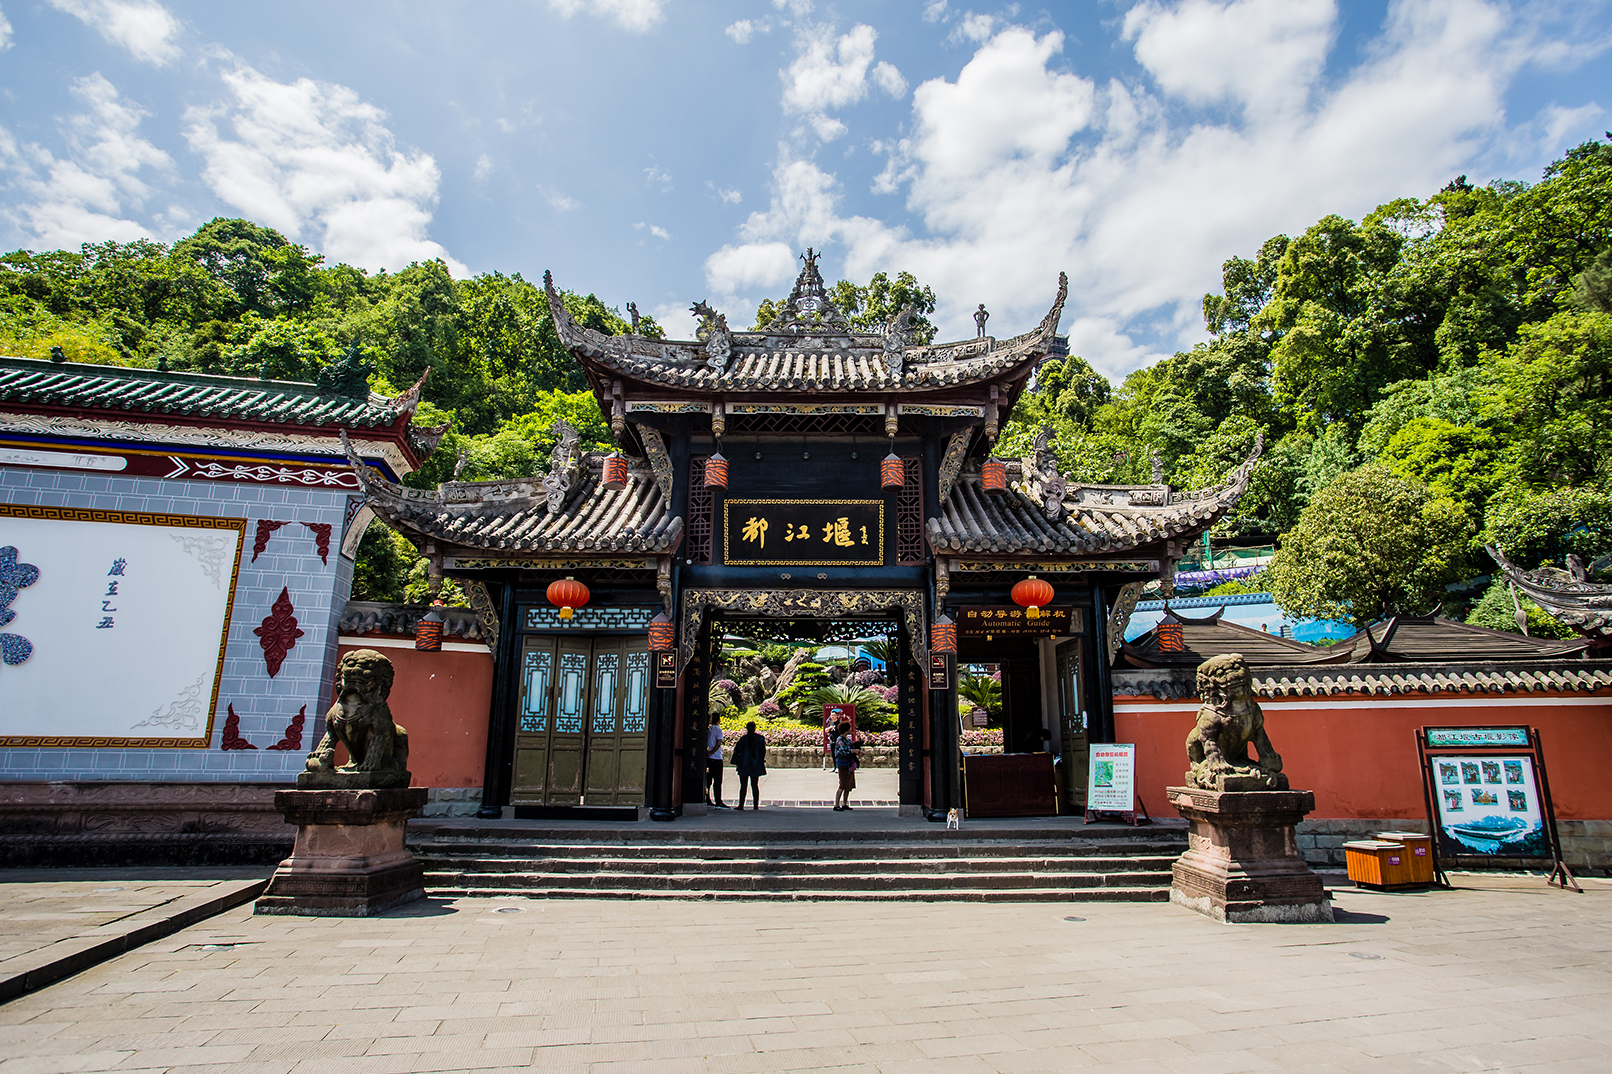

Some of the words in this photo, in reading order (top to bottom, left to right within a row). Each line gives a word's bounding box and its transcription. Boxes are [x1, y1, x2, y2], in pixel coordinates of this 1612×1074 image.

[741, 516, 856, 550] 都江堰
[967, 610, 1066, 618] 自动导游解机
